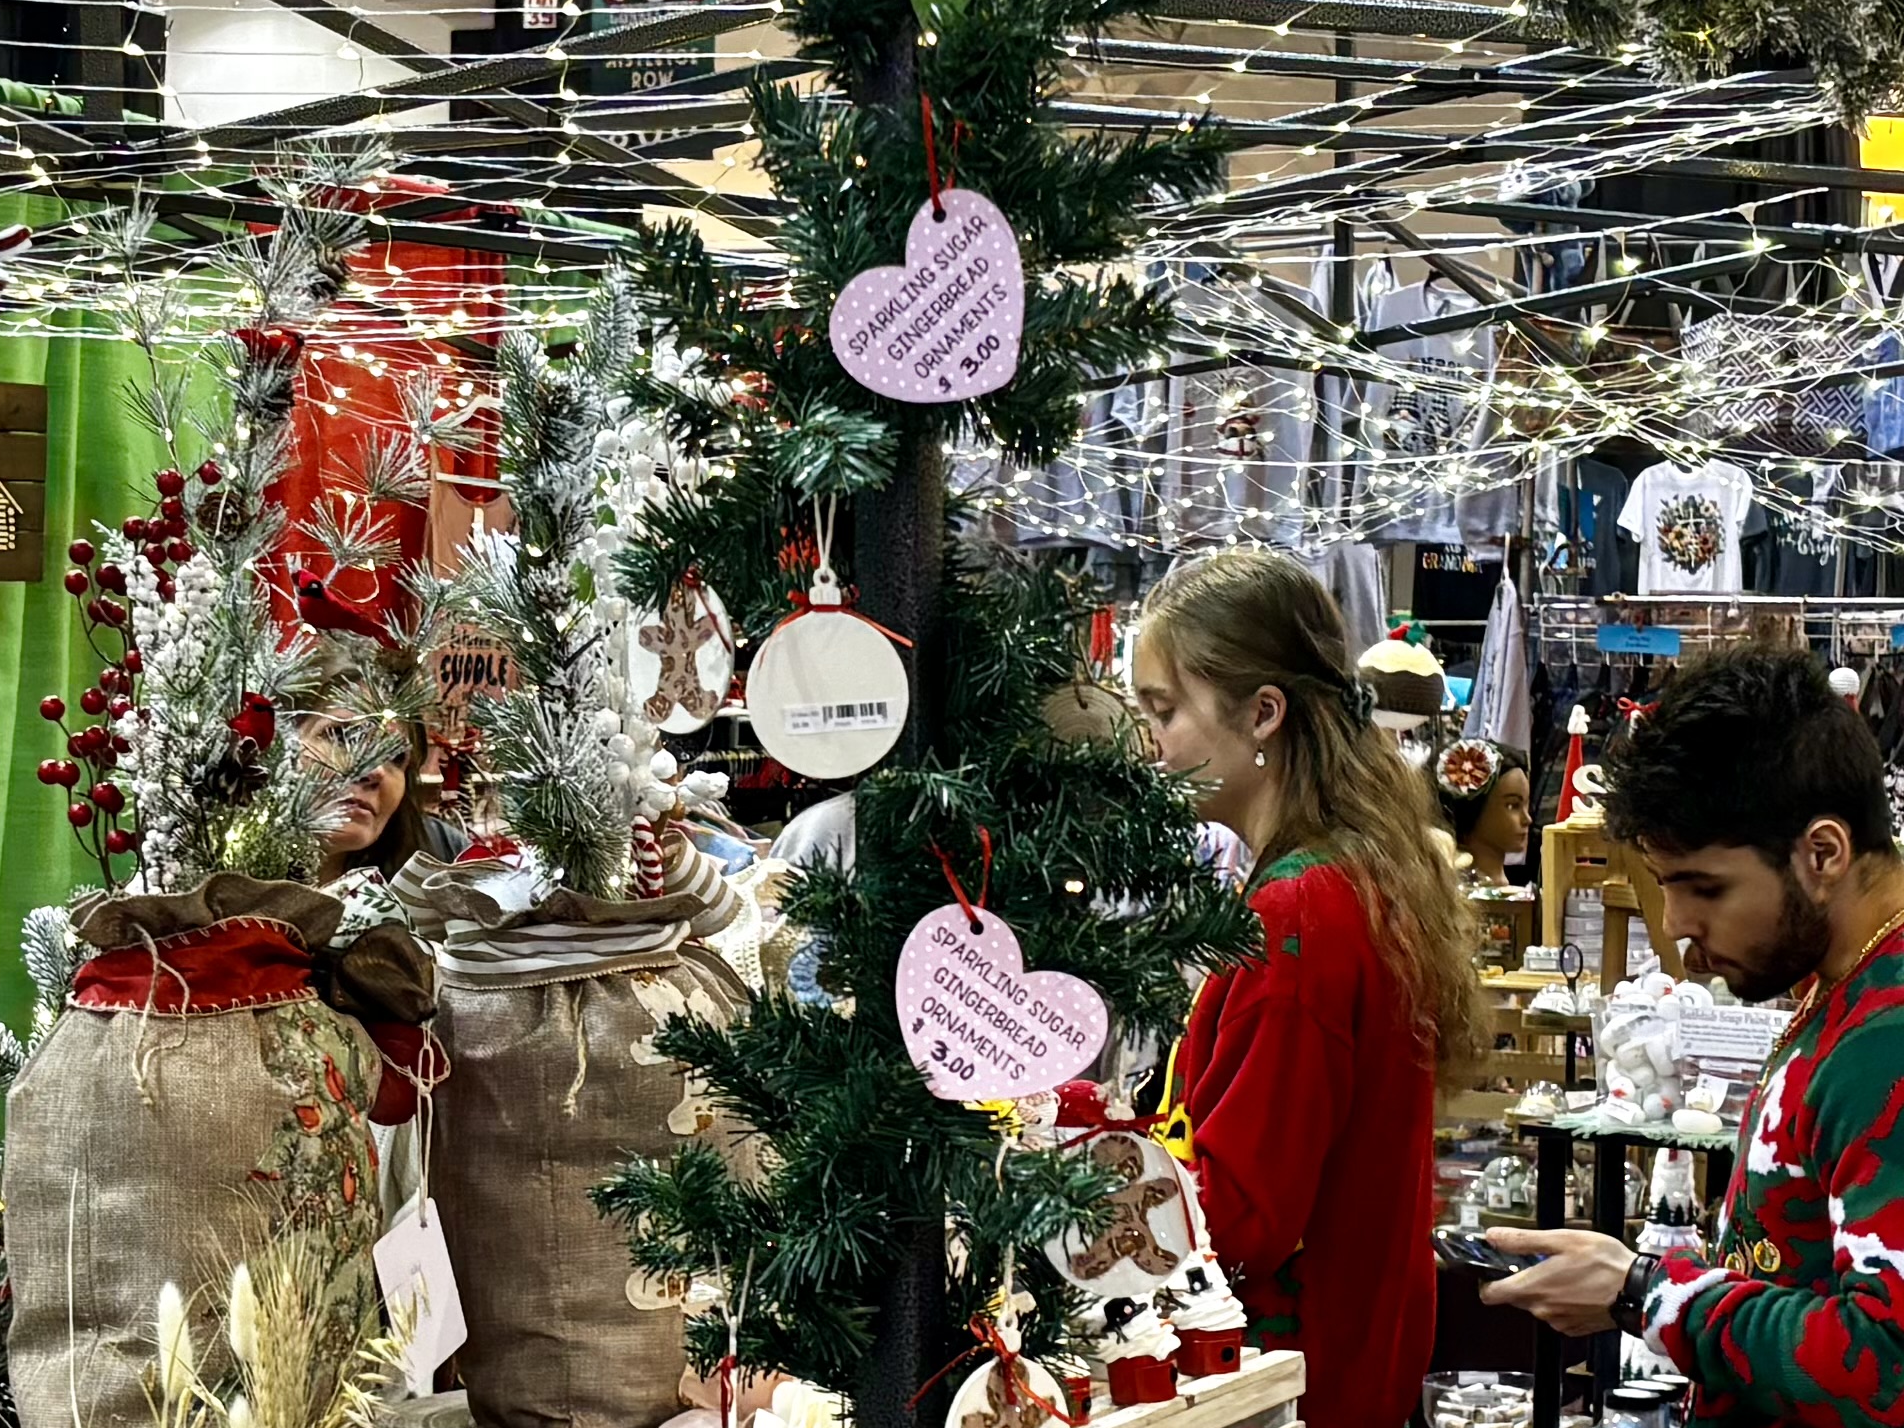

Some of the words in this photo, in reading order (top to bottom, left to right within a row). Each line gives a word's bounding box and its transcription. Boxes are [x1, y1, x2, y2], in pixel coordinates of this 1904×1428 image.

[631, 71, 674, 89] ROW
[848, 265, 937, 357] SPARKLING
[933, 214, 989, 273] SUGAR
[886, 255, 992, 363] GINGERBREAD
[913, 283, 1008, 380] ORNAMENTS
[959, 333, 1002, 379] 3.00
[932, 925, 1030, 1006] SPARKLING
[1026, 990, 1087, 1052] SUGAR
[933, 966, 1049, 1060] GINGERBREAD
[920, 996, 1028, 1082] ORNAMENTS
[930, 1039, 976, 1081] 3.00
